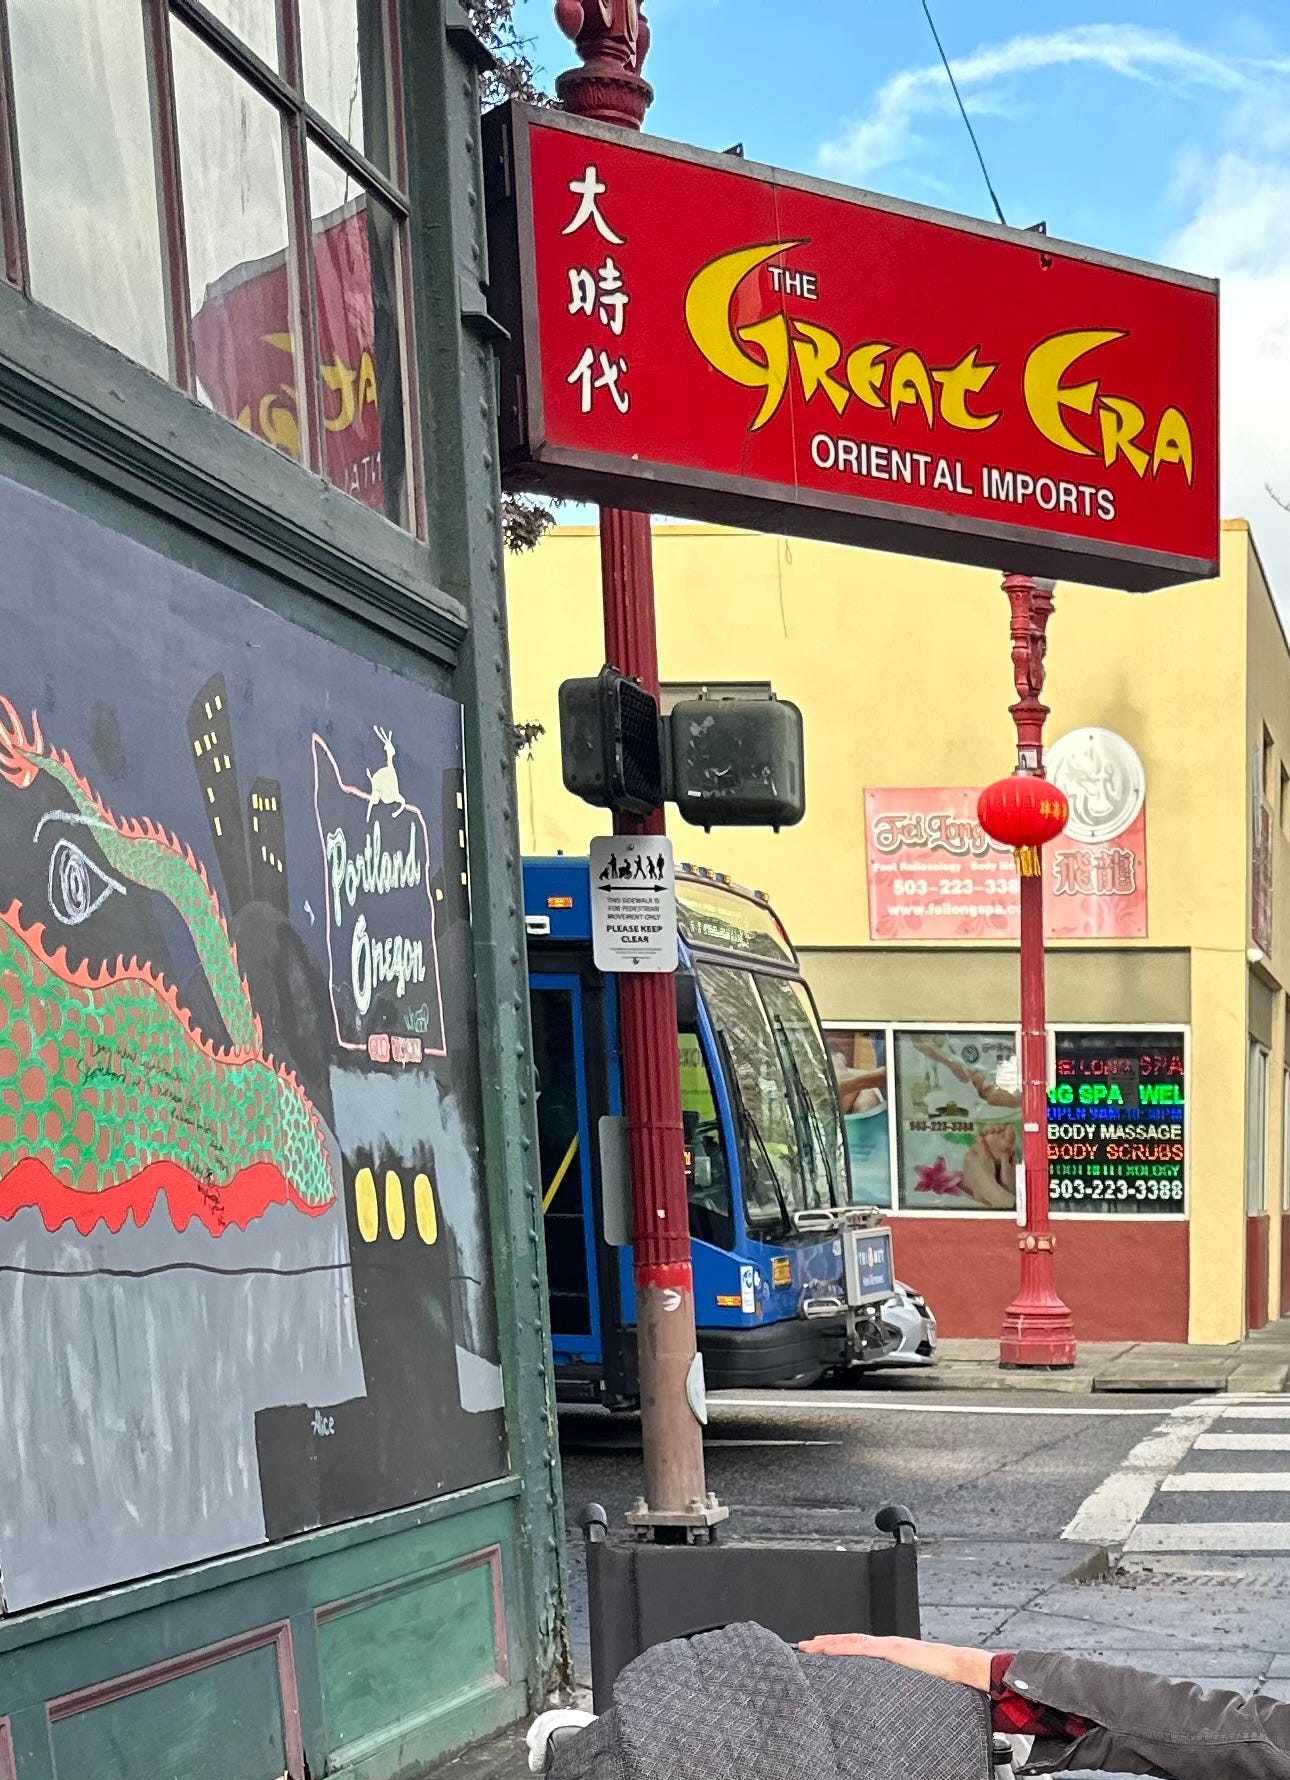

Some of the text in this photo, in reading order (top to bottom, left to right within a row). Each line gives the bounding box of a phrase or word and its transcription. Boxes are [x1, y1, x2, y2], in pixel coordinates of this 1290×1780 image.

[561, 164, 630, 415] 大時代
[767, 265, 818, 301] THE
[810, 433, 1117, 522] ORIENTAL IMPORTS
[874, 815, 925, 849] Fei
[326, 820, 421, 927] Portland
[893, 879, 1021, 896] 503-223-338
[1055, 850, 1136, 894] 飛龍
[352, 914, 425, 1016] Oregon
[1079, 1084, 1124, 1104] SPA
[1139, 1083, 1185, 1105] WEL
[1047, 1123, 1182, 1140] BODY MASSAGE
[1047, 1144, 1184, 1160] BODY SCRUBS
[1049, 1179, 1183, 1200] 503-223-3388
